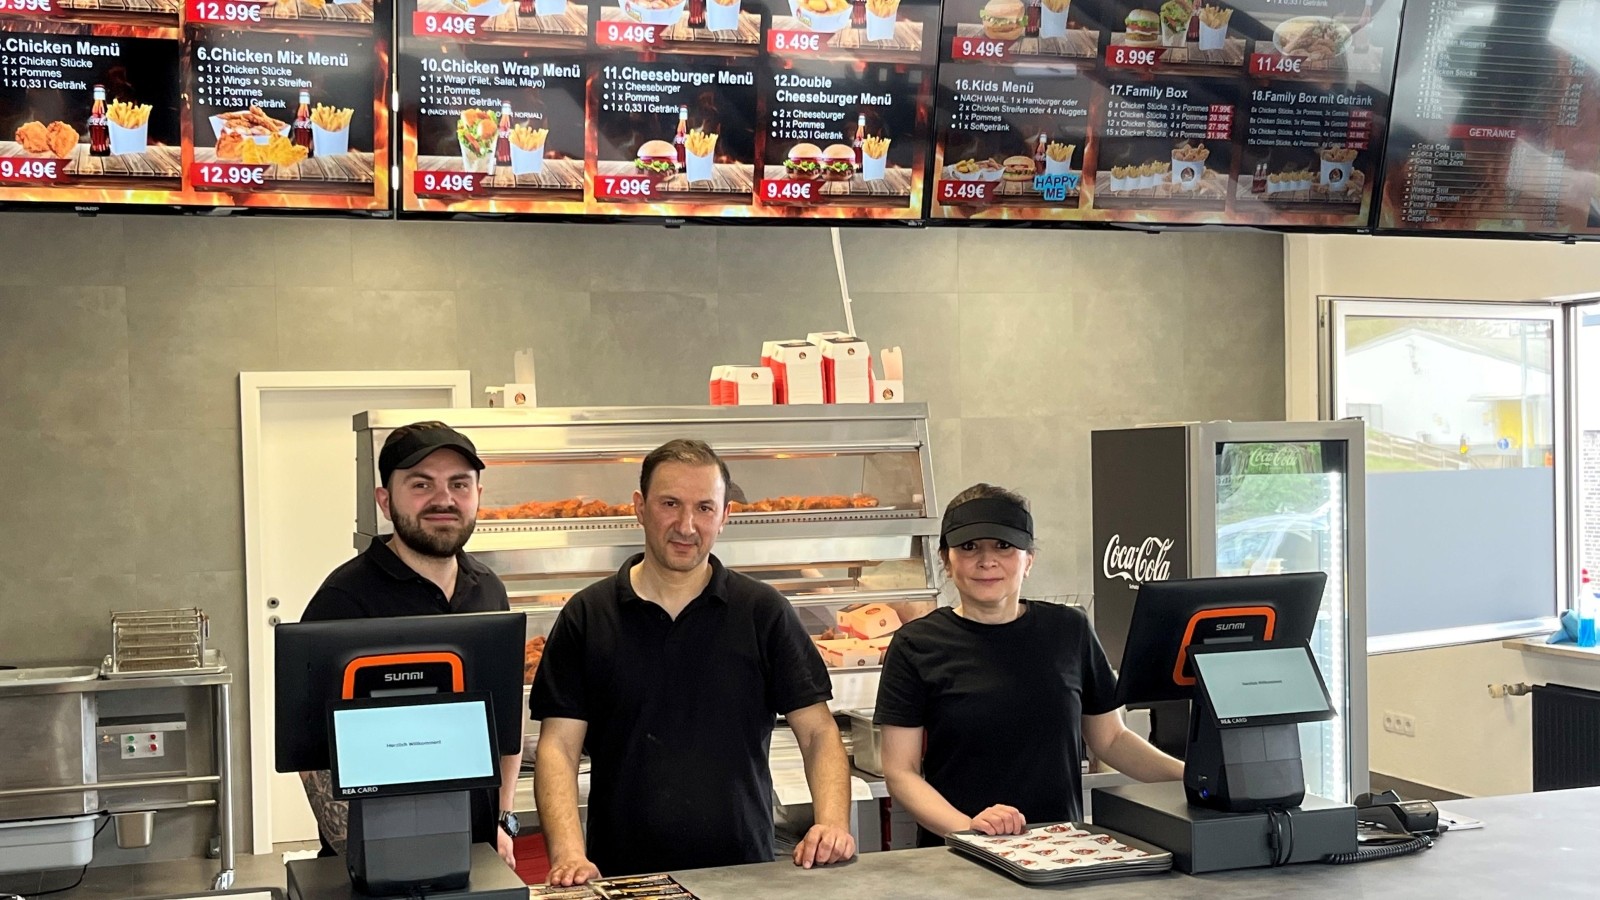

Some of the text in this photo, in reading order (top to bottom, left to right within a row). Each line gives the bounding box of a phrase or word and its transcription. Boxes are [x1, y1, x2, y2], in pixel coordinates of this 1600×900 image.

[196, 3, 261, 22] 12.99€
[426, 15, 476, 35] 9.49€
[608, 25, 655, 43] 9.49€
[775, 33, 820, 50] 8.49€
[77, 41, 120, 56] Menü
[962, 41, 1004, 57] 9.49€
[2, 56, 8, 64] 2
[19, 56, 58, 67] Chicken
[60, 58, 93, 68] Stücke
[197, 47, 349, 67] 6.Chicken Mix Menü
[222, 65, 259, 75] Chicken
[261, 66, 292, 76] Stücke
[421, 58, 581, 79] 10.Chicken Wrap Menü
[1257, 57, 1301, 73] 11.49€
[3, 67, 8, 75] 1
[20, 67, 62, 78] Pommes
[603, 66, 753, 86] 11.Cheeseburger Menü
[3, 79, 9, 87] 1
[20, 79, 41, 89] 0,33
[43, 79, 46, 88] l
[49, 80, 87, 90] Getränk
[206, 76, 211, 84] 3
[222, 76, 251, 86] Wings
[262, 78, 268, 86] 3
[278, 77, 312, 88] Streifen
[443, 76, 466, 85] Wrap
[468, 76, 492, 86] (Filet,
[494, 77, 518, 87] Salat,
[520, 78, 546, 89] Mayo)
[612, 82, 616, 90] 1
[625, 82, 681, 94] Cheeseburger
[774, 75, 832, 88] 12.Double
[955, 79, 1034, 93] 16.Kids Menü
[207, 87, 212, 95] 1
[223, 87, 263, 97] Pommes
[429, 86, 434, 94] 1
[444, 86, 480, 96] Pommes
[625, 93, 660, 102] Pommes
[207, 98, 212, 106] 1
[223, 98, 243, 108] 0,33
[245, 99, 248, 107] l
[251, 99, 286, 109] Getränk
[464, 97, 467, 105] l
[468, 97, 502, 107] Getränk
[776, 90, 892, 106] Cheeseburger Menü
[960, 94, 983, 102] NACH
[1022, 97, 1060, 107] Hamburger
[1252, 90, 1373, 106] 18.Family Box mit Getränk
[611, 103, 616, 111] 1
[624, 103, 642, 114] 0,33
[644, 104, 647, 112] l
[648, 104, 679, 114] Getränk
[971, 104, 999, 112] Chicken
[1002, 105, 1027, 114] Streifen
[1030, 106, 1045, 114] oder
[1059, 108, 1087, 117] Nuggets
[779, 110, 785, 118] 2
[793, 110, 845, 121] Cheeseburger
[971, 114, 1001, 122] Pommes
[779, 120, 783, 128] 1
[792, 120, 825, 129] Pommes
[970, 123, 1009, 133] Softgetränk
[792, 131, 808, 140] 0,33
[810, 131, 813, 139] l
[814, 131, 843, 140] Getränk
[1, 160, 57, 179] 9.49€
[200, 166, 264, 185] 12.99€
[424, 174, 474, 192] 9.49€
[605, 179, 650, 195] 7.99€
[1036, 176, 1077, 190] HAPPY
[767, 183, 811, 199] 9.49€
[944, 184, 985, 199] 5.49€
[1046, 188, 1064, 199] ME
[1216, 622, 1246, 631] SUNMI
[384, 671, 424, 682] SUNMI
[358, 786, 378, 794] CARD
